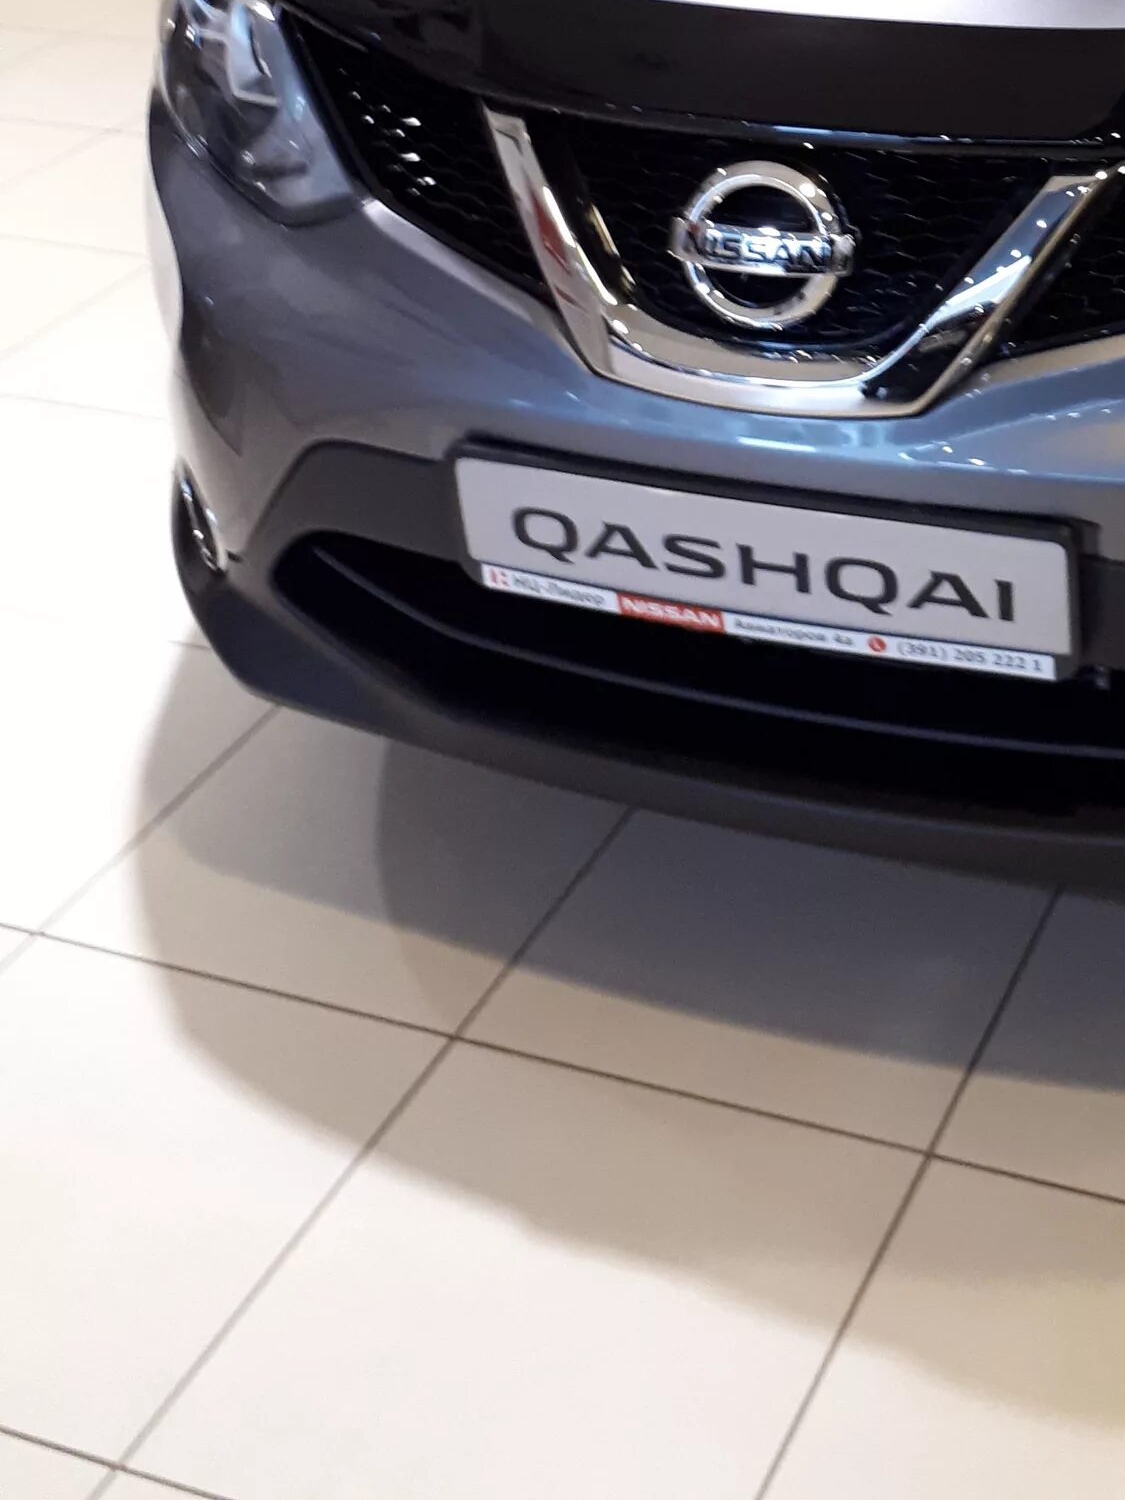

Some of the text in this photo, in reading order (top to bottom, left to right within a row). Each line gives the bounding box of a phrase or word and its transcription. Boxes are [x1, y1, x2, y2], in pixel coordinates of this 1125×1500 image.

[687, 222, 832, 273] NISSAN
[511, 506, 1015, 622] QASHQAI
[620, 595, 719, 628] NISSAN
[896, 639, 1043, 672] (391) 205 222 1
